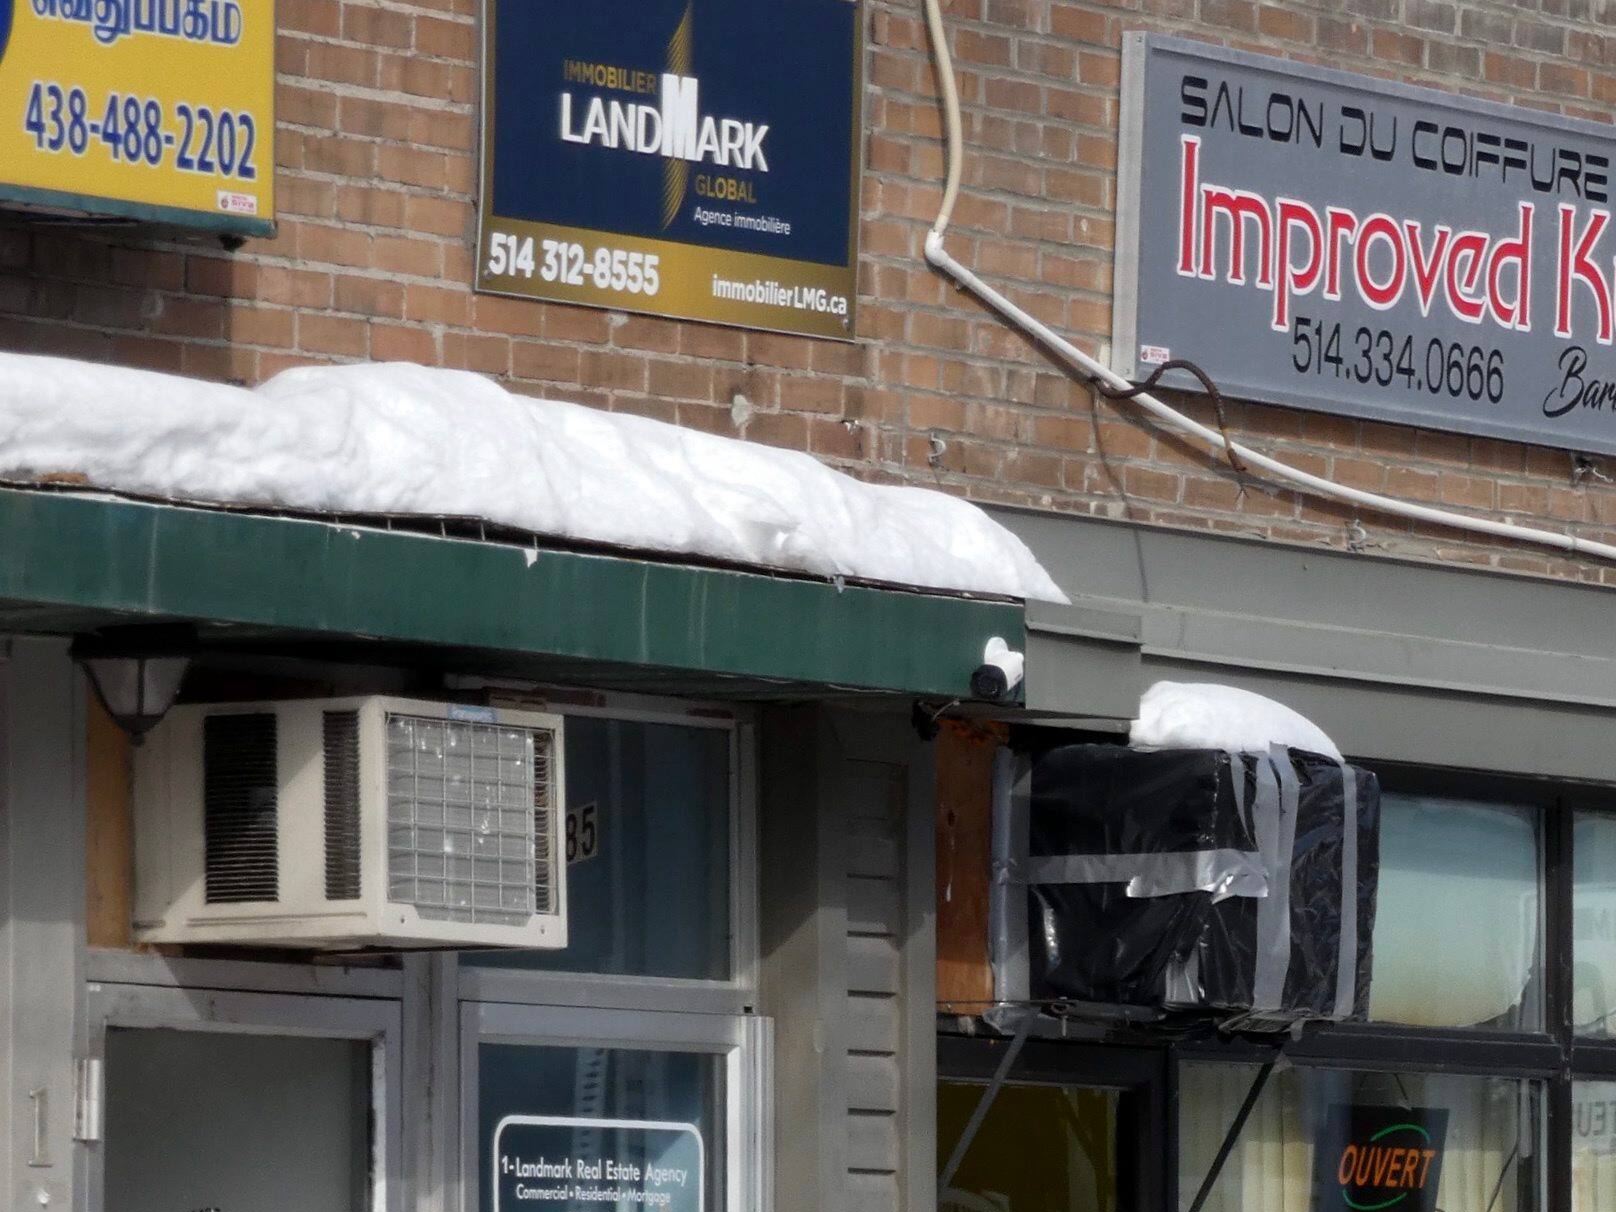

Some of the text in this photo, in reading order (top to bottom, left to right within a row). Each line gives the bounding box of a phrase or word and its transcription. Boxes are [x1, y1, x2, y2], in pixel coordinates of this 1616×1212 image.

[564, 59, 658, 94] IMMOBILIER
[25, 81, 257, 180] 438-488-2202
[560, 73, 770, 172] LANDMARK
[1181, 75, 1610, 203] SALON DU COIFFURE
[694, 174, 757, 203] GLOBAL
[694, 206, 791, 235] Agence immobilière
[1176, 134, 1535, 333] Improved
[489, 232, 660, 296] 514 312-8555
[1292, 316, 1504, 404] 514.334.0666
[515, 1157, 572, 1178] Landmark
[577, 1158, 602, 1180] Real
[606, 1160, 640, 1181] Estate
[644, 1163, 687, 1187] Agency
[1337, 1143, 1436, 1190] OUVERT
[516, 1184, 671, 1206] Commercial Residential Mortgage
